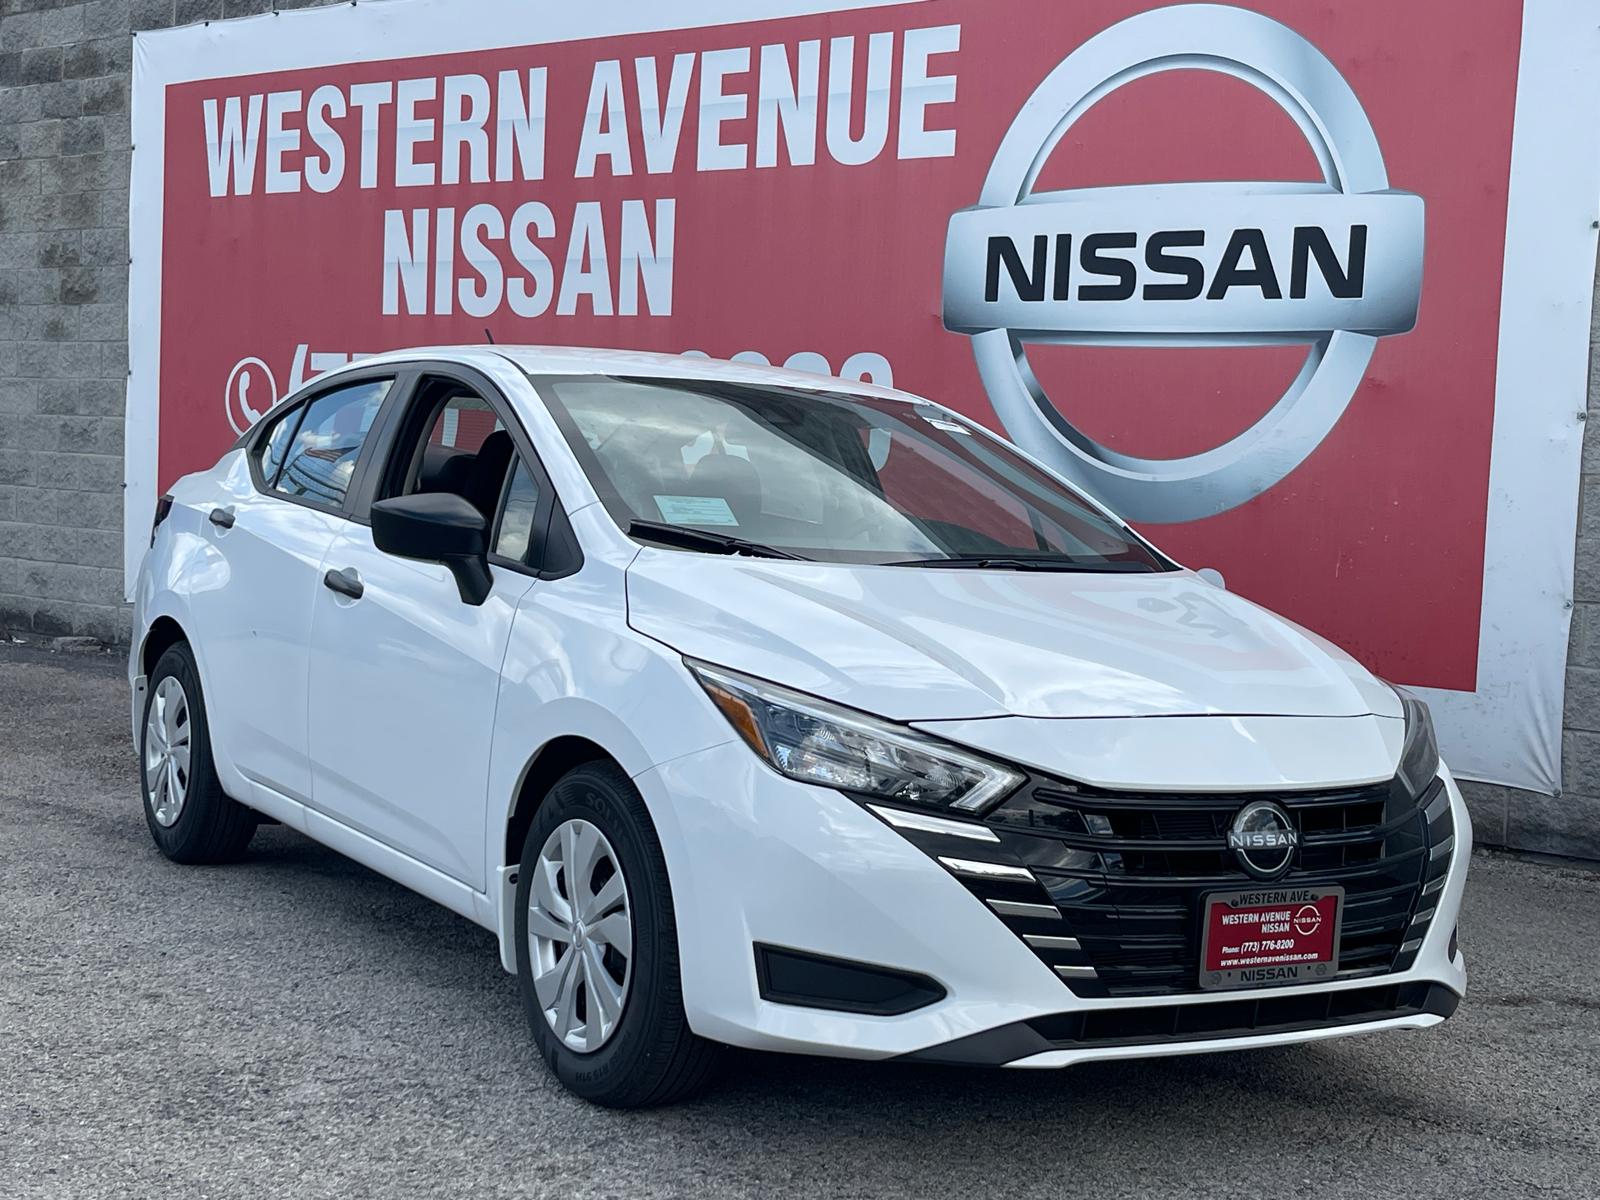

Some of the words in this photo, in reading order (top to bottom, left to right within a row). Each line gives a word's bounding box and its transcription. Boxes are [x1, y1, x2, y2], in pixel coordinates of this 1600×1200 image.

[203, 66, 548, 198] WESTERN
[574, 24, 961, 178] AVENUE
[382, 198, 676, 318] NISSAN
[985, 224, 1368, 302] NISSAN
[1230, 832, 1298, 847] NISSAN
[1240, 891, 1287, 905] WESTERN
[1222, 912, 1259, 925] WESTERN
[1260, 911, 1291, 923] AVENUE
[1293, 916, 1322, 924] NISSAN
[1261, 922, 1290, 934] NISSAN
[1222, 946, 1240, 954] Phone:
[1241, 940, 1260, 954] (773)
[1261, 938, 1295, 951] 776-8200
[1220, 952, 1319, 967] www.westernavenissan.com
[1240, 966, 1298, 982] NISSAN
